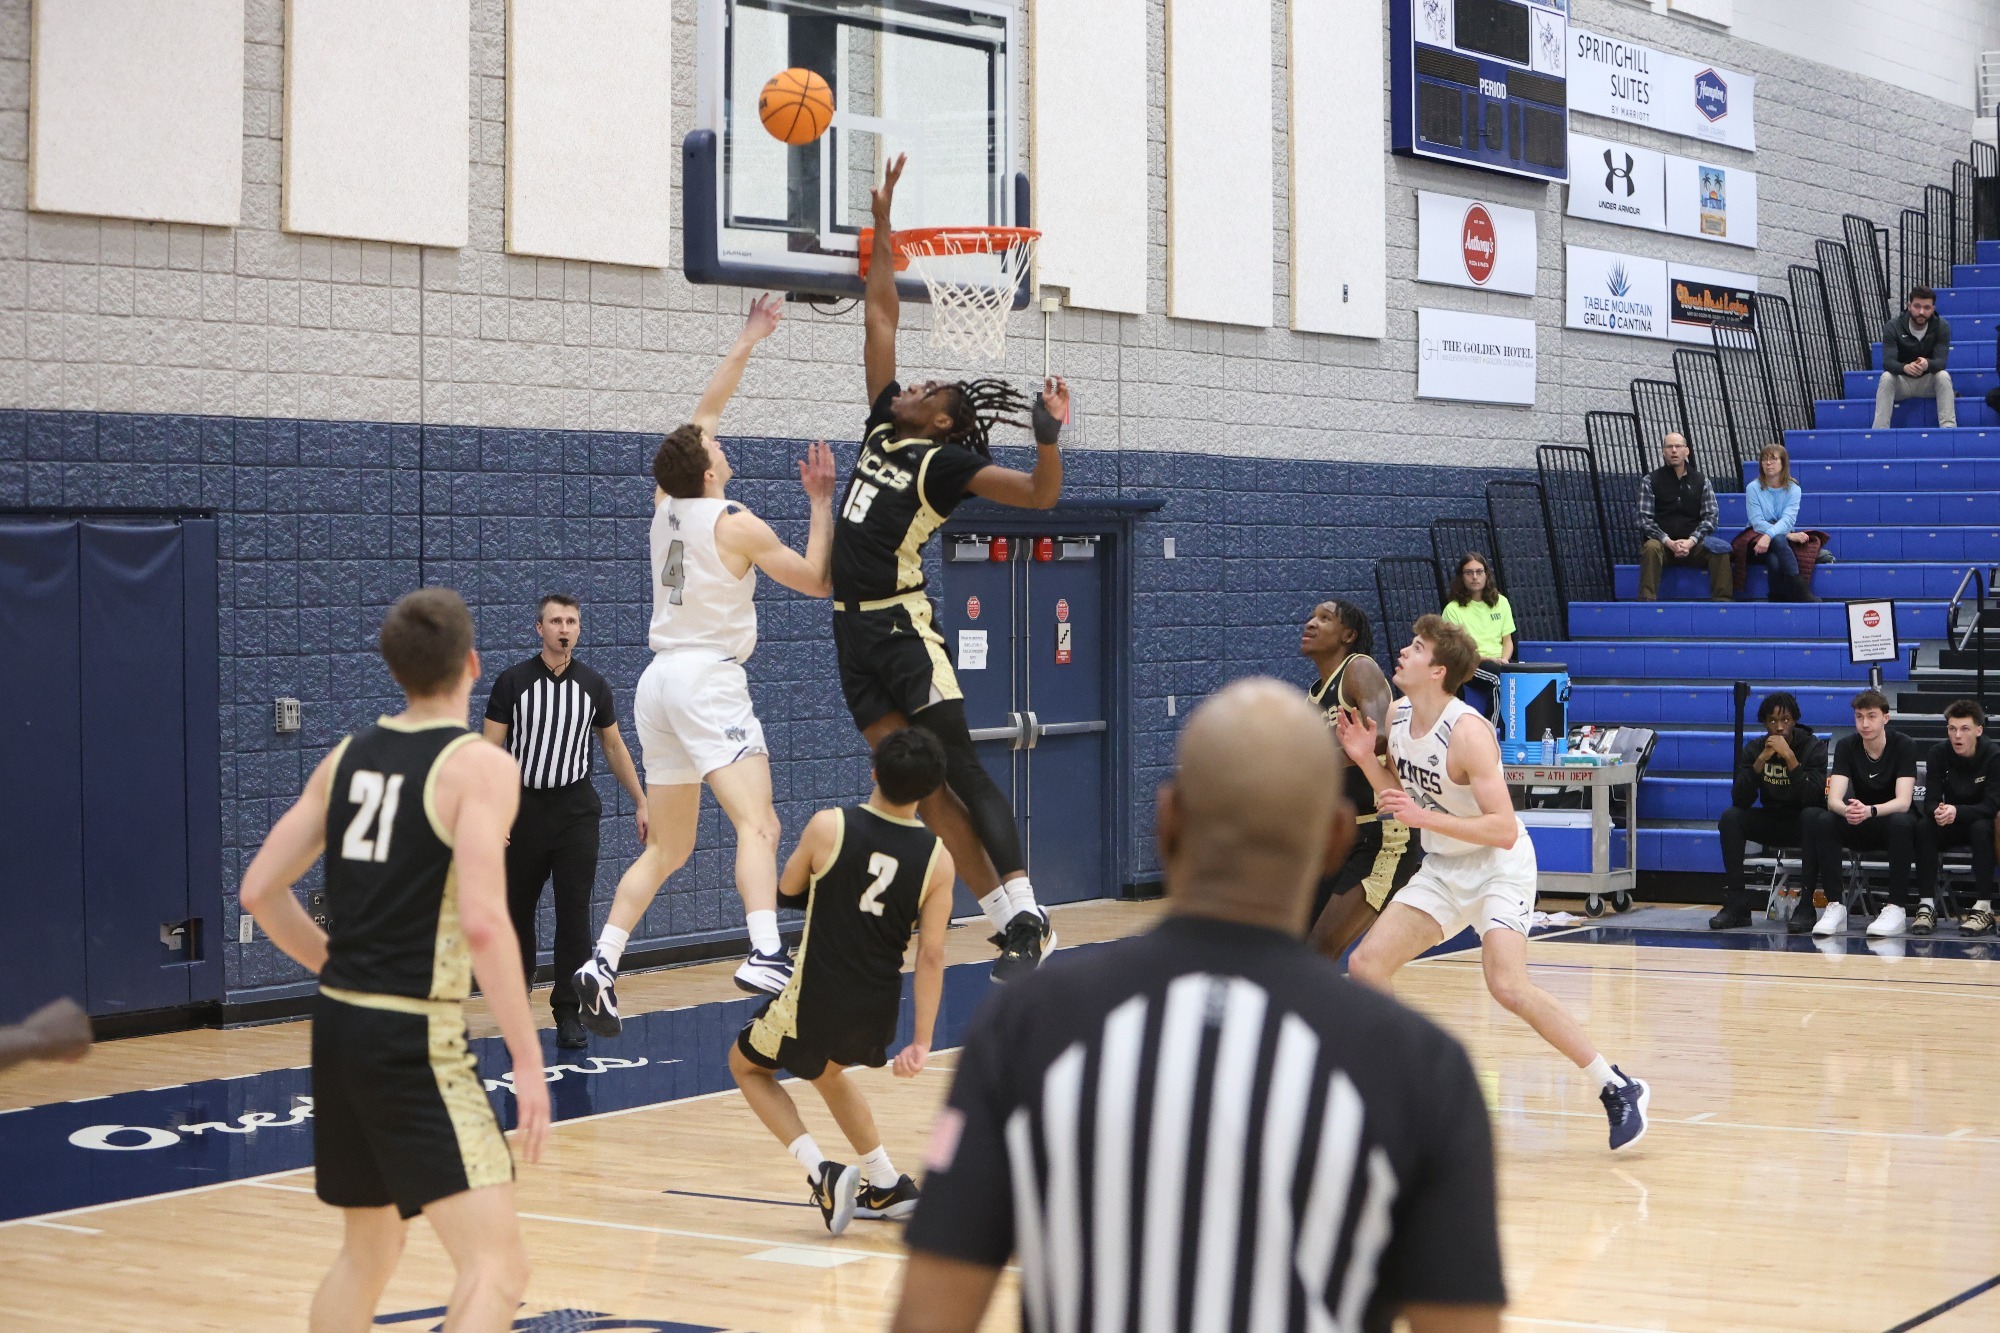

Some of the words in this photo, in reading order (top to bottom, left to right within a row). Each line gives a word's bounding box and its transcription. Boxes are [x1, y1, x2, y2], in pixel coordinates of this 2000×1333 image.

[1578, 34, 1649, 74] SPRINGHILL
[1479, 77, 1507, 99] PERIOD
[1611, 74, 1649, 104] SUITES
[1611, 105, 1619, 114] BY
[1621, 107, 1650, 122] MARRIOTT
[1598, 200, 1616, 210] UNDER
[1618, 204, 1641, 215] ARMOUR
[1465, 229, 1494, 259] Anthony's
[1584, 296, 1609, 311] TABLE
[1611, 300, 1652, 317] MOUNTAIN
[1584, 312, 1607, 327] GRILL
[1617, 317, 1652, 332] CANTINA
[1442, 340, 1461, 352] THE
[1464, 342, 1501, 355] GOLDEN
[1503, 346, 1533, 359] HOTEL
[842, 478, 880, 523] 15
[661, 539, 685, 606] 4
[1509, 677, 1517, 740] POWERADE
[1547, 771, 1565, 781] ATH
[1570, 771, 1593, 781] DEPT
[341, 769, 405, 863] 21
[859, 851, 899, 917] 2
